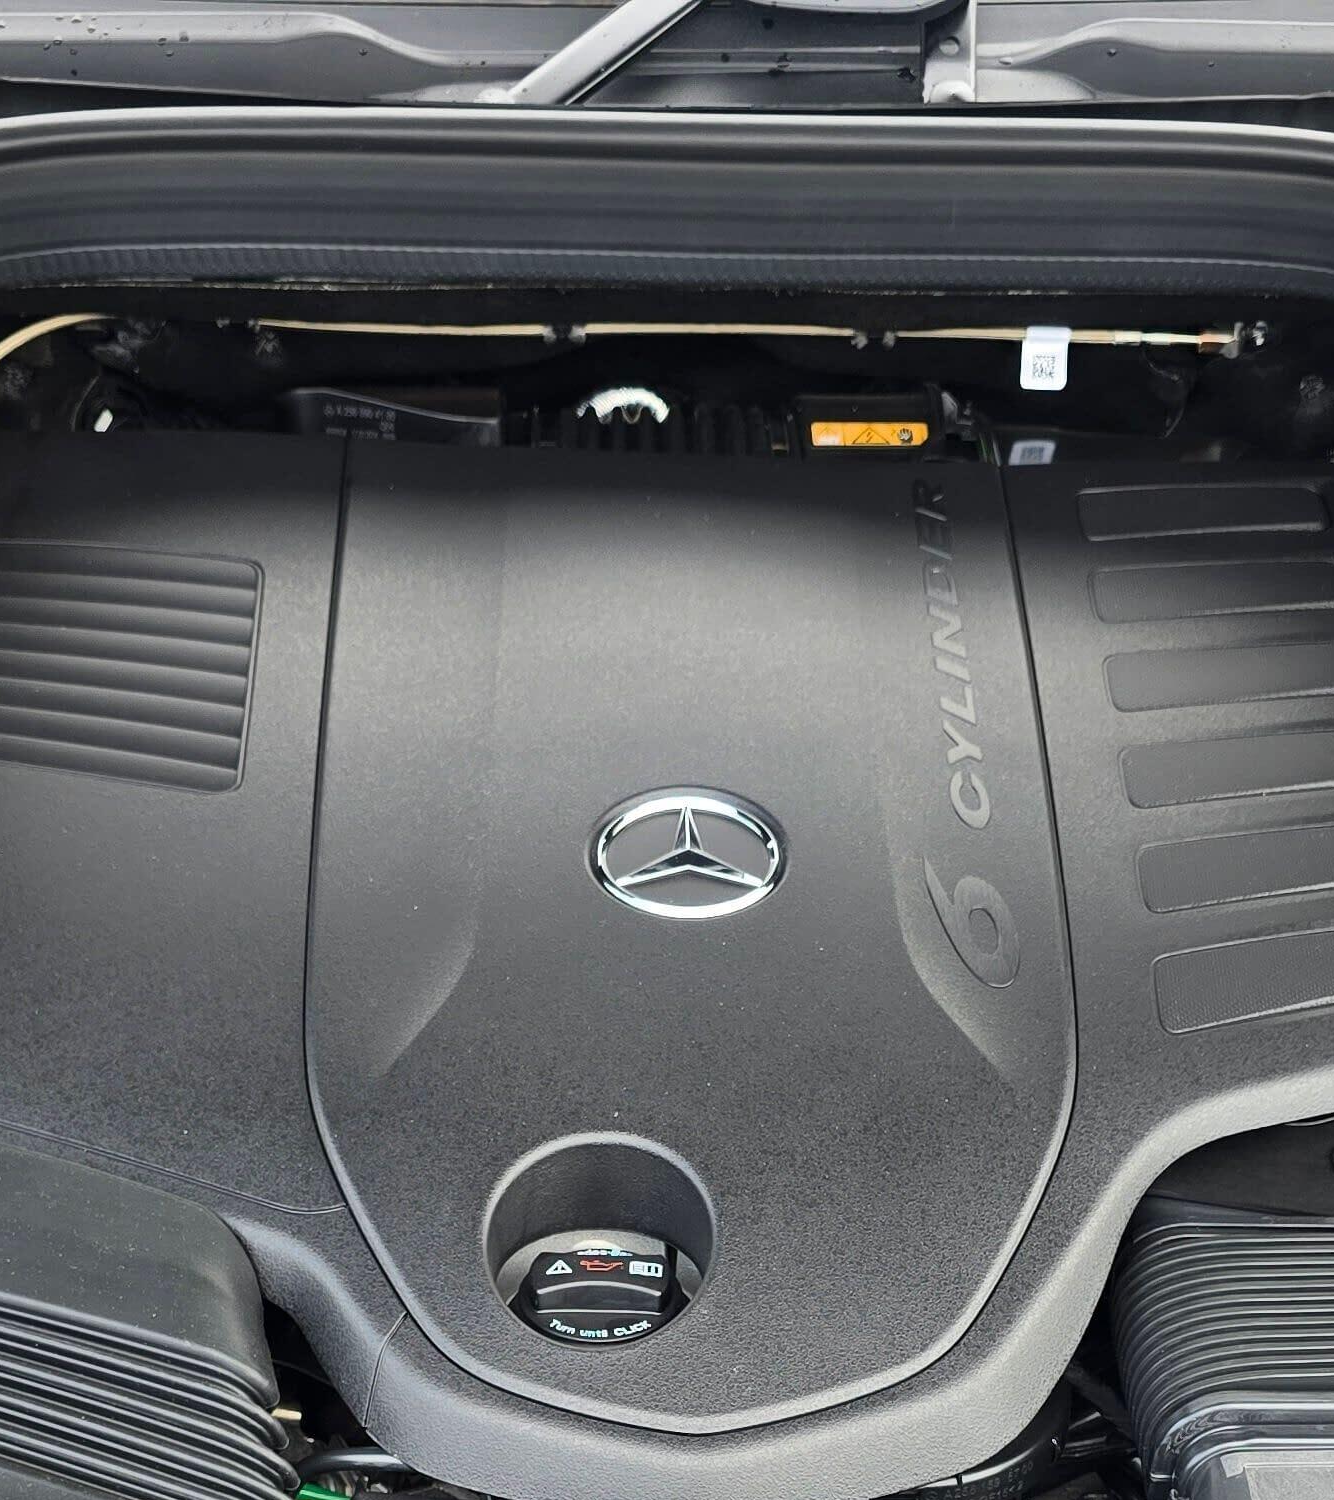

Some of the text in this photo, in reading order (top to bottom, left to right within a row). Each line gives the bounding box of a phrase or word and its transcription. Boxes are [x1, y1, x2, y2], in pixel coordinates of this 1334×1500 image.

[912, 479, 1020, 990] 6 CYLINDER
[549, 1318, 652, 1338] Turn until CLICK
